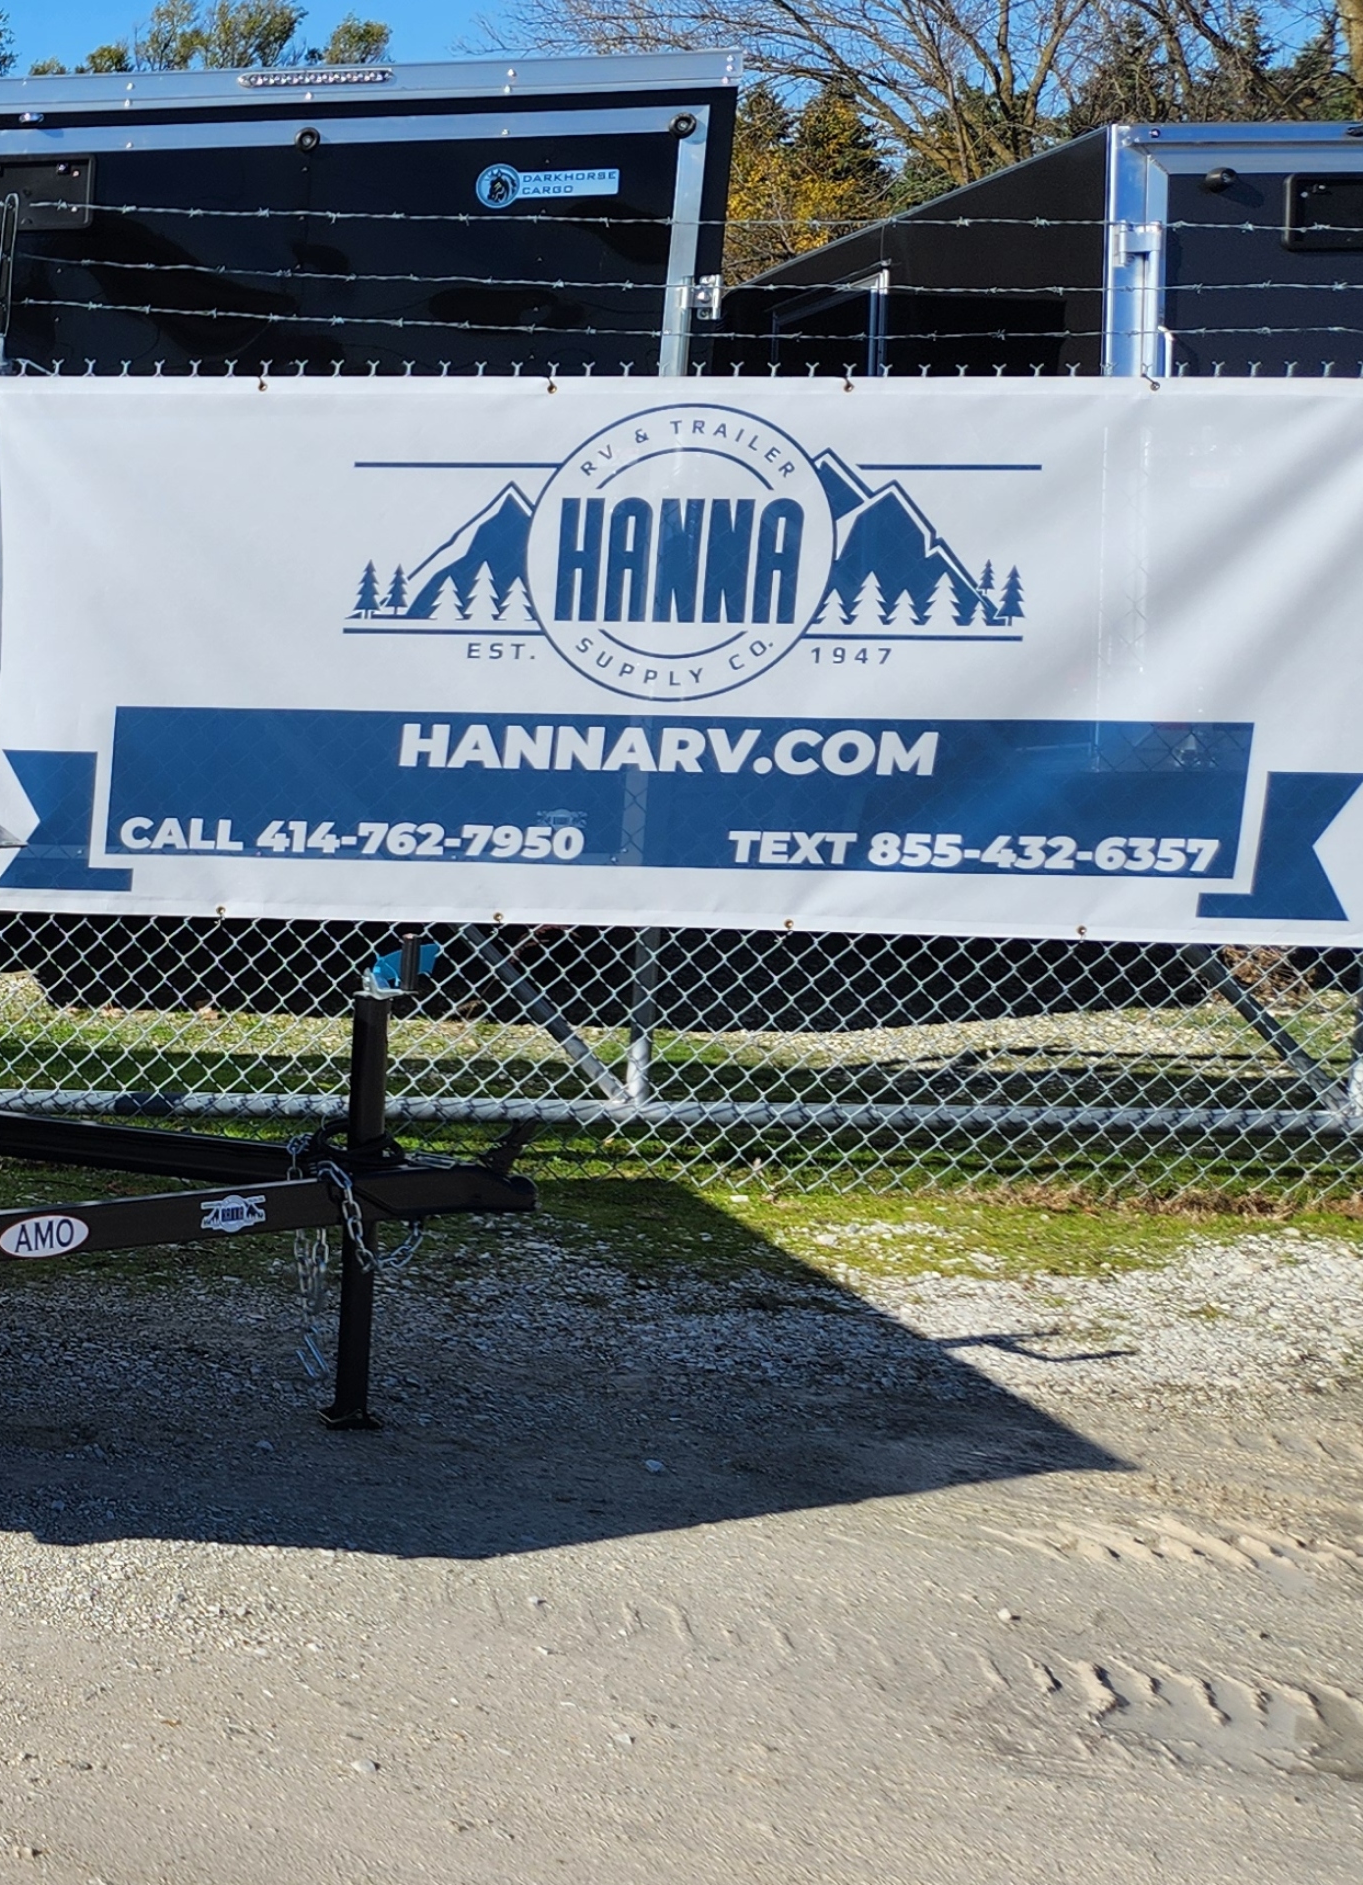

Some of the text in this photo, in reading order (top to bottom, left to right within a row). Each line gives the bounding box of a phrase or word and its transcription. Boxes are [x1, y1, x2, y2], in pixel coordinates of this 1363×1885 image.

[522, 171, 617, 182] DARKHORSE
[522, 185, 574, 195] CARGO
[580, 420, 796, 478] RV & TRAILER
[554, 497, 805, 624] HANNA
[467, 642, 536, 660] EST.
[575, 637, 774, 686] SUPPLY CO.
[810, 647, 892, 664] 1947
[398, 723, 939, 777] HANNARV.COM
[119, 816, 585, 860] CALL 414-762-7950
[727, 830, 1220, 873] TEXT 855-432-6357
[15, 1218, 74, 1252] AMO
